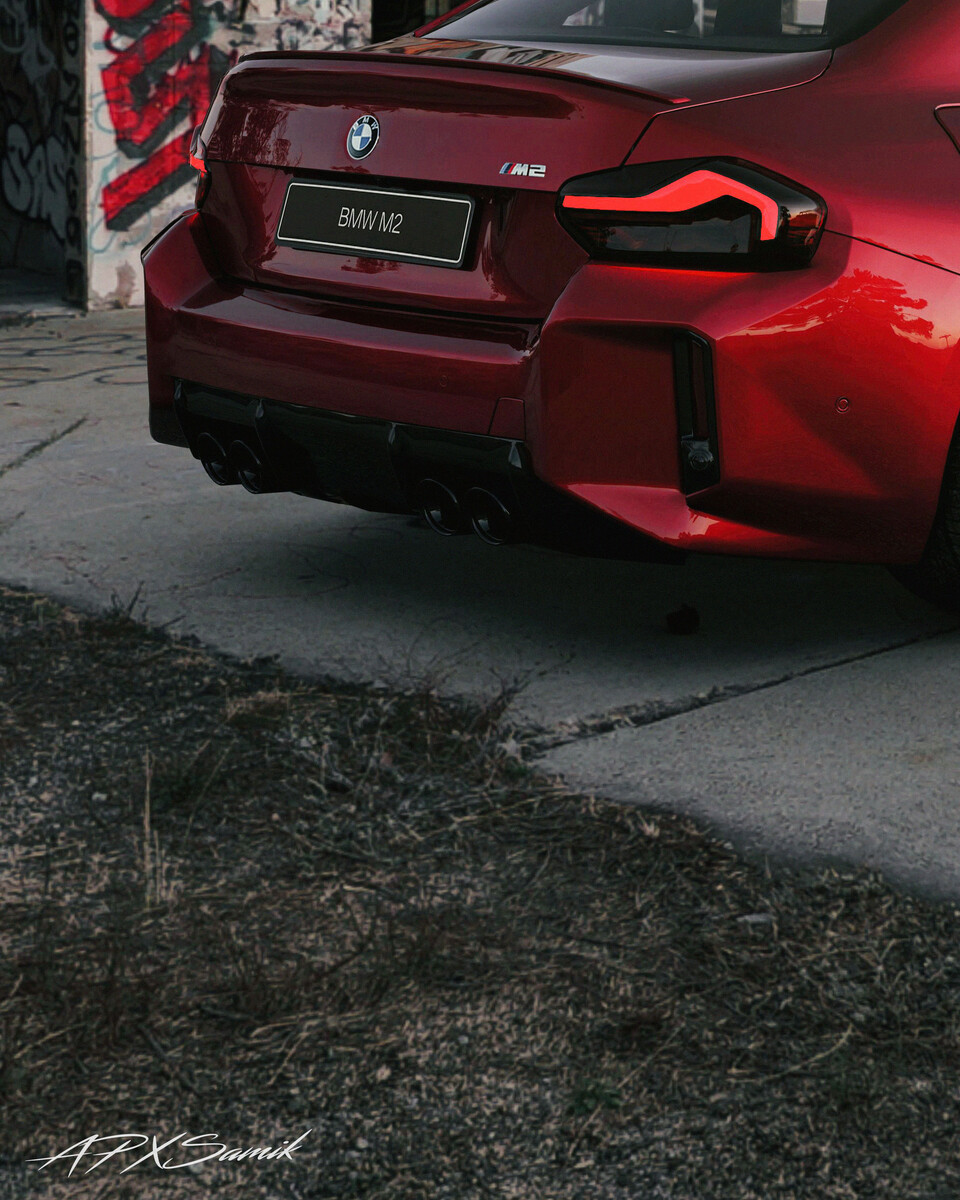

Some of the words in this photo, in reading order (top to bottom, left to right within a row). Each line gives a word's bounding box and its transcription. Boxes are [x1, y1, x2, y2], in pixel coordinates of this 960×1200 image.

[510, 162, 546, 177] M2
[338, 207, 379, 230] BMW
[378, 211, 403, 234] M2
